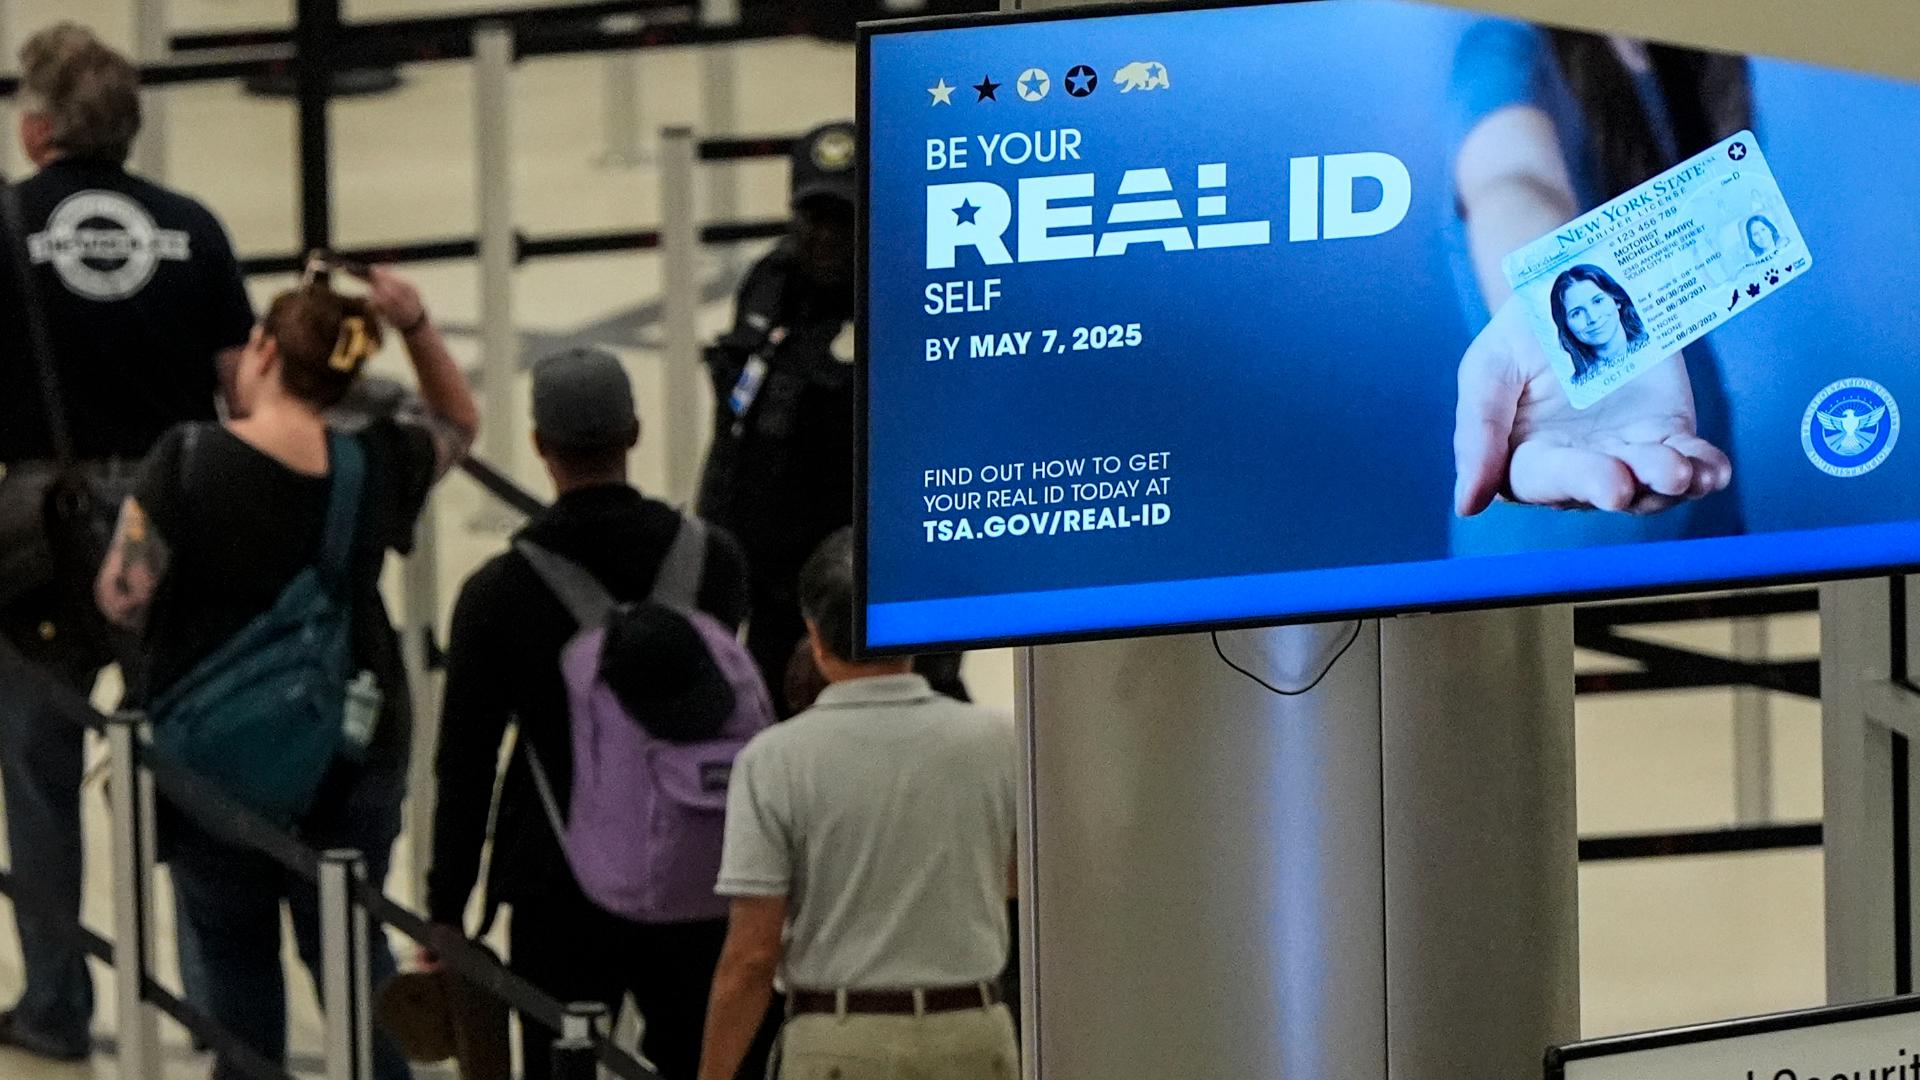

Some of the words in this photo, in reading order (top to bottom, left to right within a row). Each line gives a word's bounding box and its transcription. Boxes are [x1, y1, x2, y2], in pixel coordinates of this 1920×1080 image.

[926, 136, 968, 171] BE
[976, 128, 1082, 167] YOUR
[926, 162, 1271, 270] REAL
[1289, 151, 1412, 243] ID
[1556, 217, 1601, 249] NEW
[1601, 192, 1653, 222] YORK
[1652, 164, 1705, 197] STATE
[1586, 216, 1632, 245] DRIVER
[1637, 186, 1688, 217] LICENSE
[1616, 229, 1636, 244] 123
[1638, 218, 1657, 232] 456
[1658, 206, 1677, 220] 789
[1613, 229, 1659, 258] MOTORIST
[924, 278, 1001, 315] SELF
[925, 337, 958, 362] BY
[970, 332, 1032, 359] MAY
[1042, 329, 1066, 356] 7,
[1072, 323, 1143, 351] 2025
[924, 467, 973, 488] FIND
[980, 463, 1025, 483] OUT
[1032, 458, 1086, 480] HOW
[1092, 456, 1121, 475] TO
[1128, 451, 1171, 472] GET
[923, 491, 980, 513] YOUR
[986, 487, 1038, 508] REAL
[1044, 485, 1065, 504] ID
[1070, 479, 1140, 502] TODAY
[1145, 477, 1171, 496] AT
[922, 503, 1171, 543] TSA.GOV/REAL-ID
